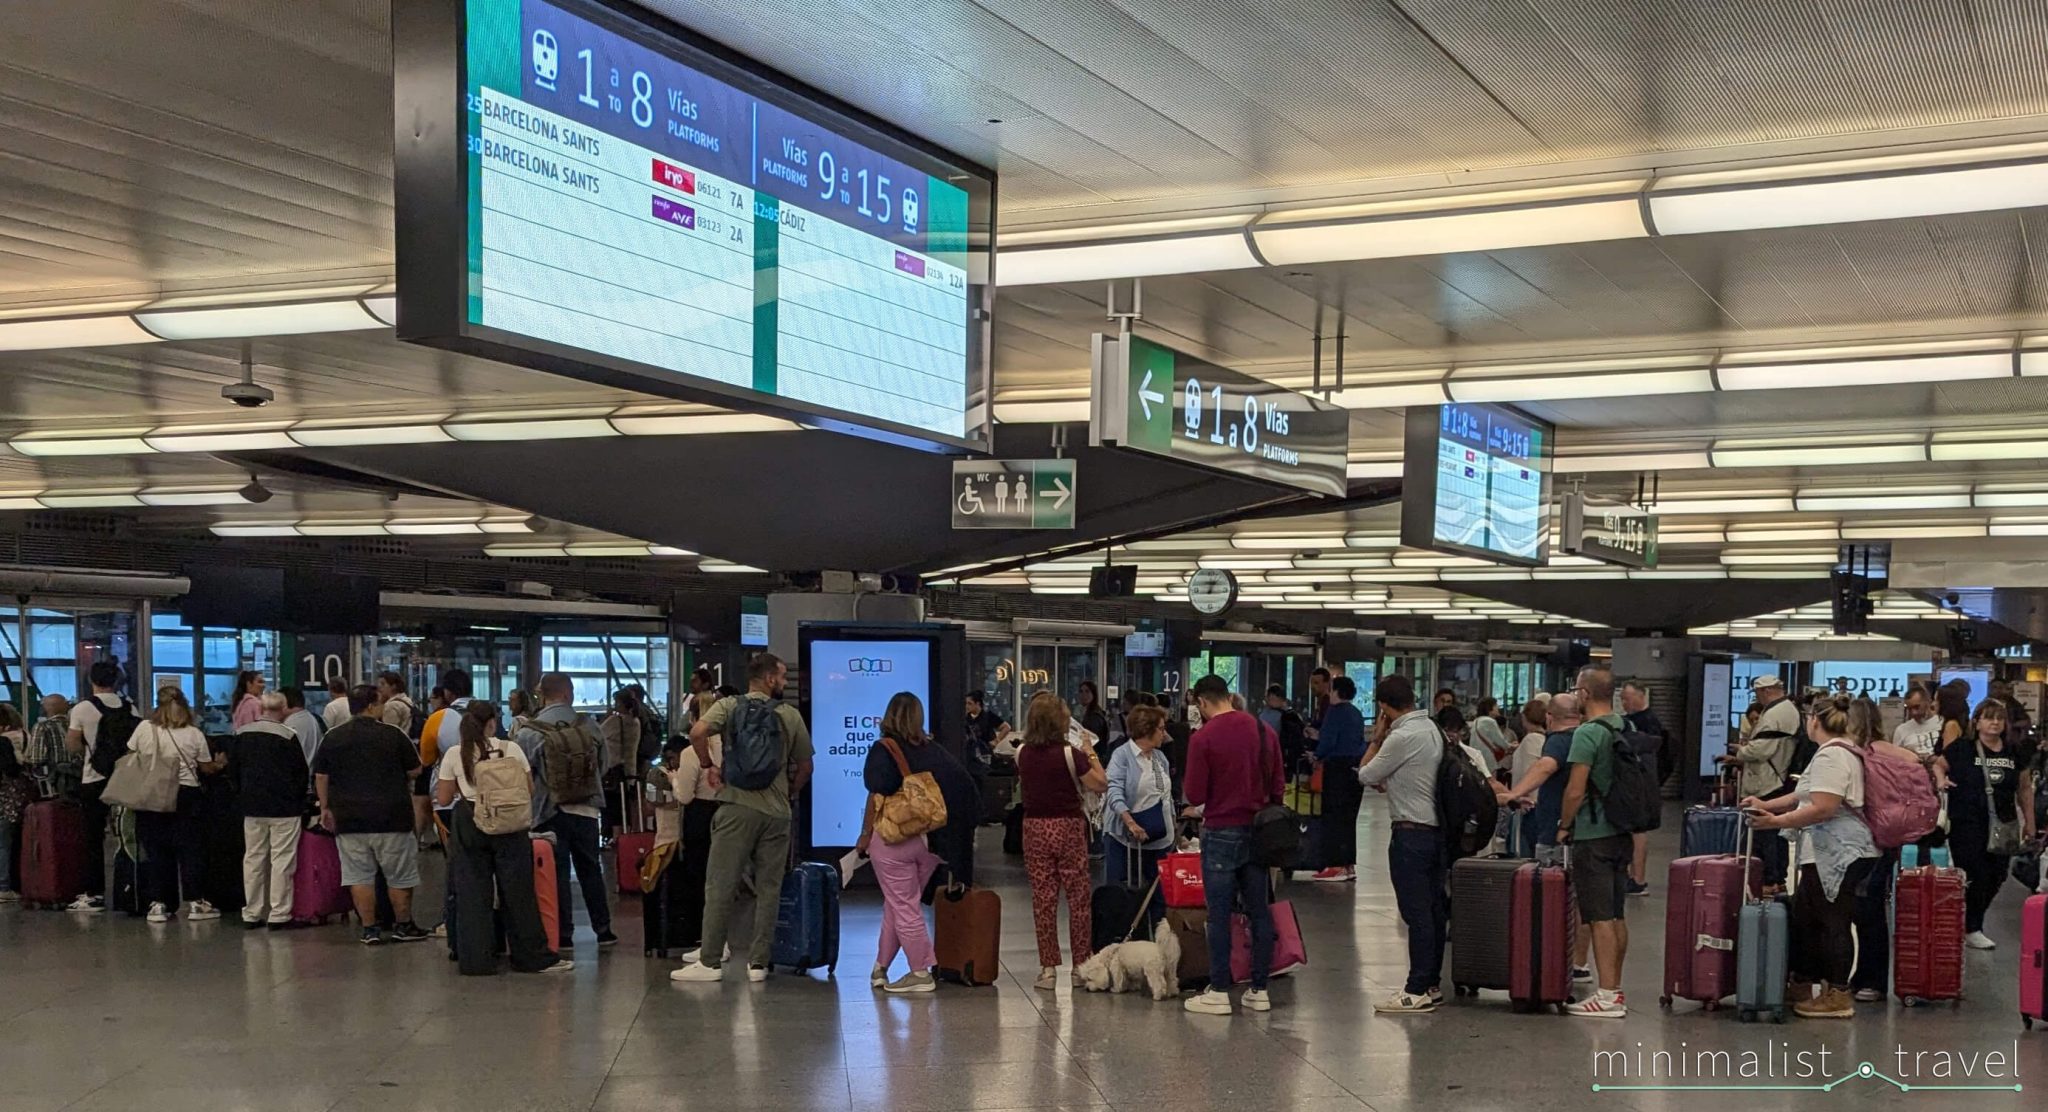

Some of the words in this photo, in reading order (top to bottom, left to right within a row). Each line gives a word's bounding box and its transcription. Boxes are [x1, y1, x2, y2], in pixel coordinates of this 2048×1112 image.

[577, 48, 600, 109] 1
[610, 67, 620, 87] a
[631, 71, 653, 128] 8
[668, 87, 698, 121] Vías
[608, 94, 621, 114] TO
[484, 98, 558, 142] BARCELONA
[563, 128, 600, 156] SANTS
[668, 120, 719, 152] PLATFORMS
[484, 139, 559, 181] BARCELONA
[563, 167, 600, 194] SANTS
[763, 157, 808, 188] PLATFORMS
[782, 137, 808, 166] Vías
[818, 151, 836, 200] 9
[841, 168, 849, 184] a
[857, 169, 891, 223] 15
[730, 191, 744, 210] 7A
[840, 189, 850, 205] TO
[671, 211, 693, 225] AVE
[753, 201, 780, 224] 12:05
[780, 206, 806, 232] CÁDIZ
[730, 226, 744, 244] 2A
[949, 273, 964, 291] 12A
[1210, 384, 1224, 446] 1
[1229, 425, 1237, 448] a
[1242, 395, 1258, 454] 8
[1264, 401, 1289, 437] Vías
[1263, 445, 1299, 467] PLATFORMS
[976, 473, 991, 483] WC
[303, 654, 343, 687] 10
[699, 662, 722, 690] 1
[1163, 670, 1180, 692] 12
[844, 716, 857, 728] El
[846, 731, 875, 744] que
[843, 769, 849, 777] Y
[1974, 757, 2015, 769] BUSSELS
